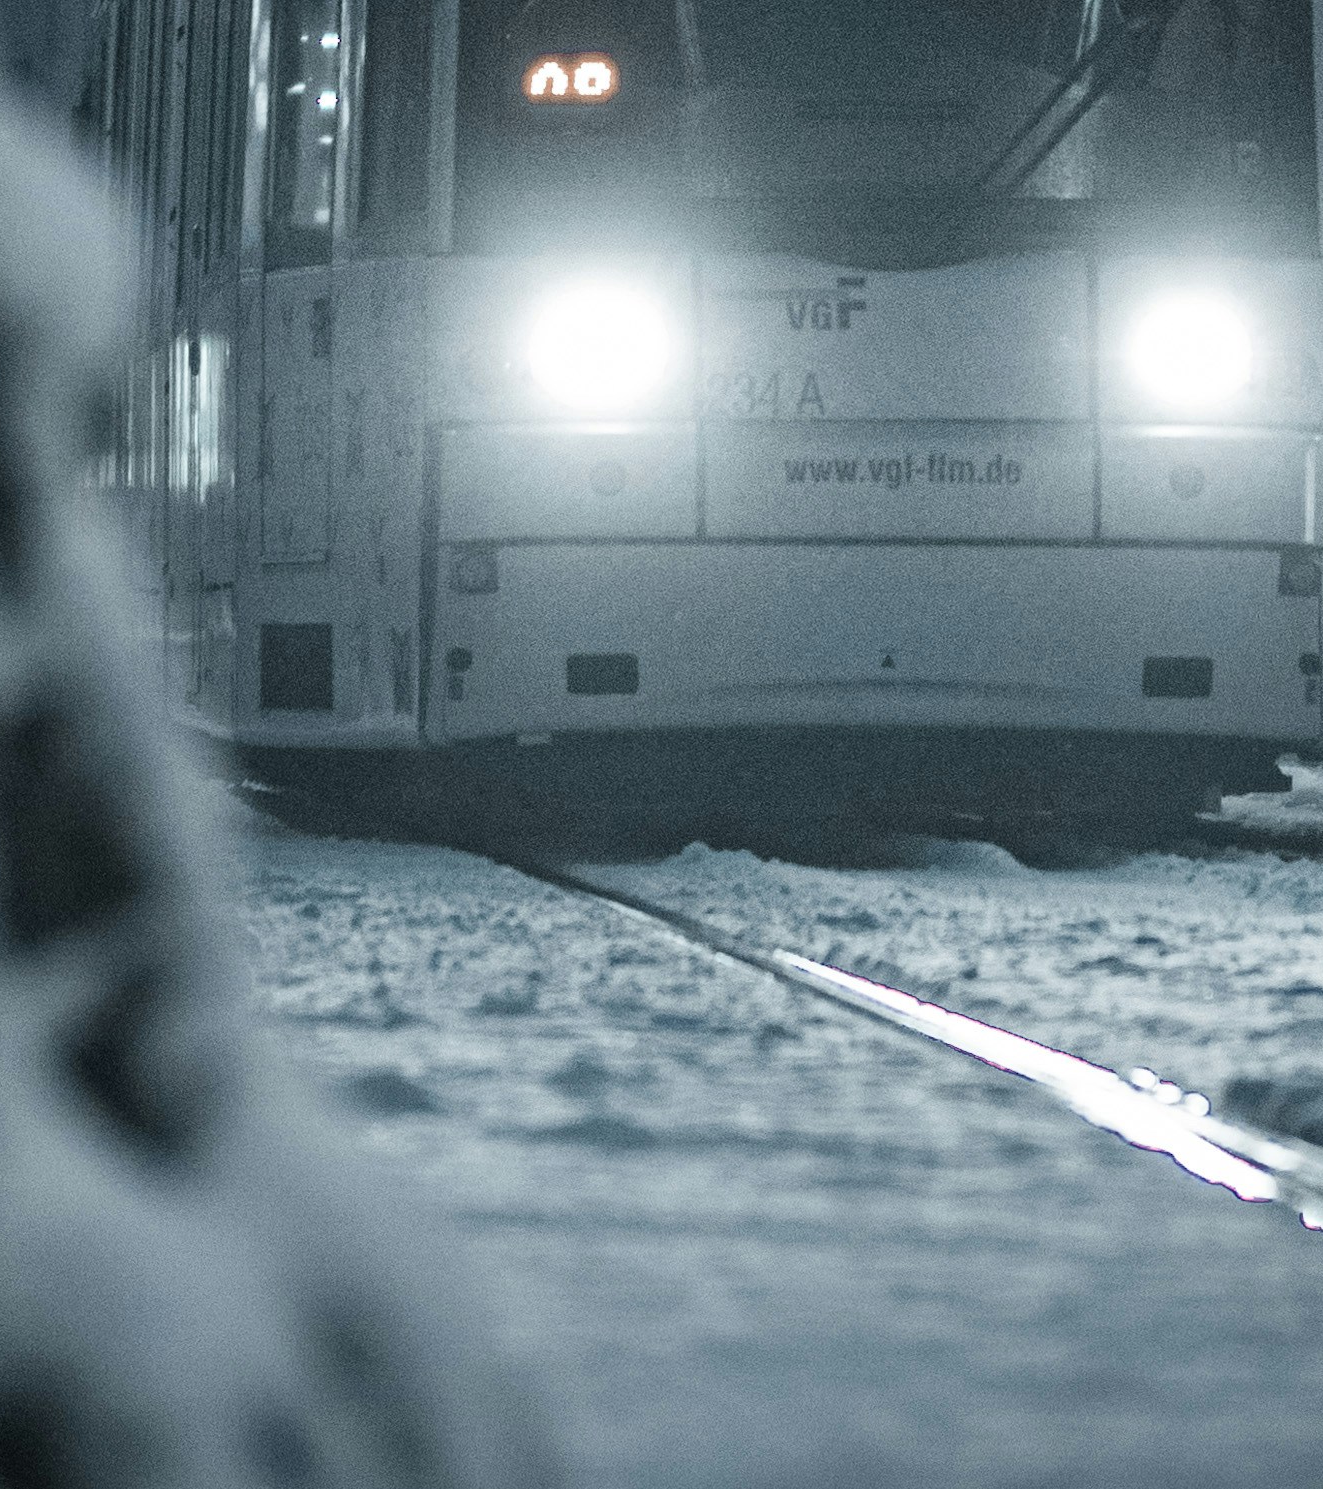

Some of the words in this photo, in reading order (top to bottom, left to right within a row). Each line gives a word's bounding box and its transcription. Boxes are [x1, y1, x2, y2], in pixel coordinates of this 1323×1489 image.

[785, 277, 867, 330] VGF
[797, 371, 826, 415] A
[783, 452, 1023, 489] www.vgf-ffm.de
